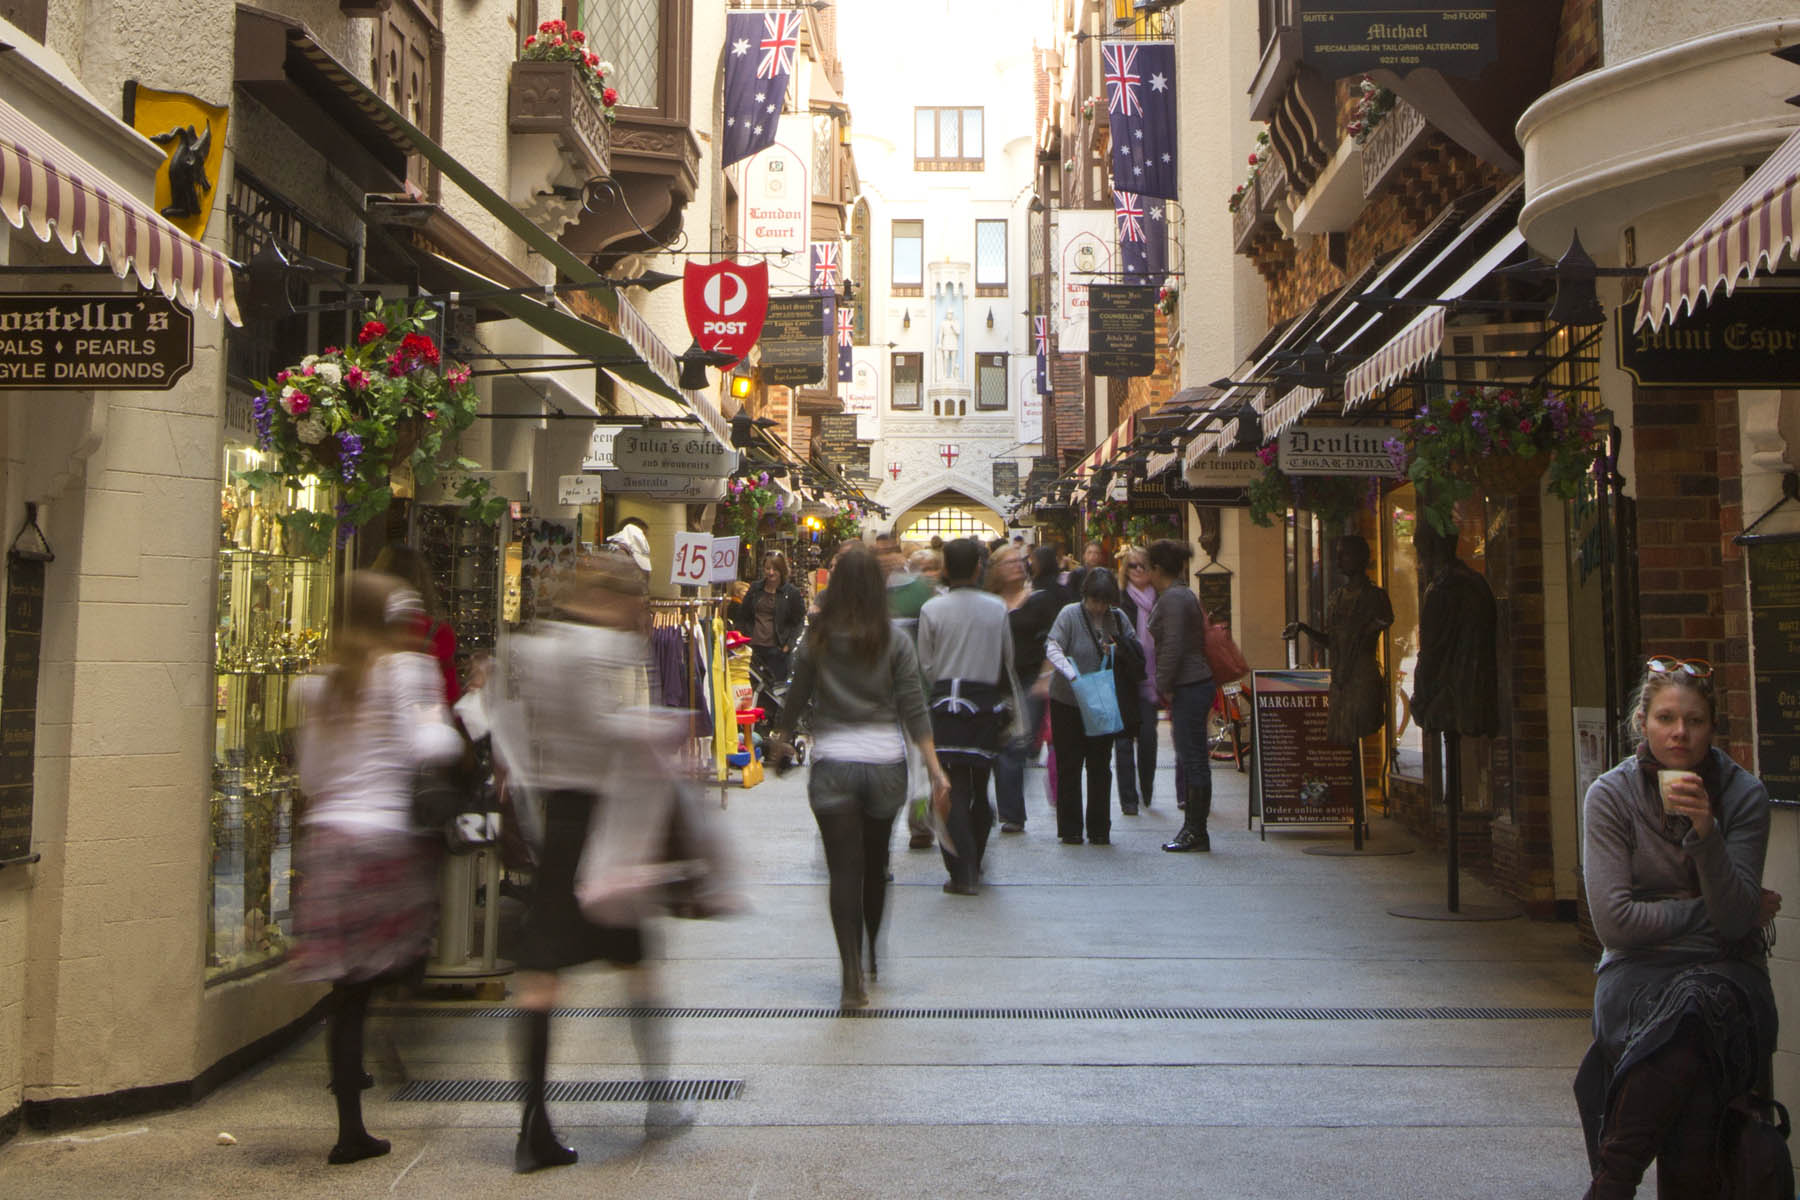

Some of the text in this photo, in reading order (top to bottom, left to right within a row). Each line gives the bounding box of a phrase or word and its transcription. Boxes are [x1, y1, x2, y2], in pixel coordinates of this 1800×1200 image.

[1459, 12, 1488, 20] FLOOR
[1367, 23, 1428, 40] Michael
[1425, 42, 1480, 51] ALTERATIONS
[749, 207, 801, 220] London
[755, 226, 795, 238] Court
[0, 302, 169, 332] ostello's
[703, 321, 748, 335] POST
[1724, 321, 1800, 356] Espr
[75, 339, 156, 355] PEARLS
[0, 362, 165, 378] GYLE DIAMONDS
[593, 433, 613, 443] een
[626, 437, 725, 456] Julia's Gifts
[675, 543, 708, 580] $15
[1259, 695, 1317, 708] MARGARET
[1265, 806, 1292, 814] Order
[1295, 805, 1323, 814] online
